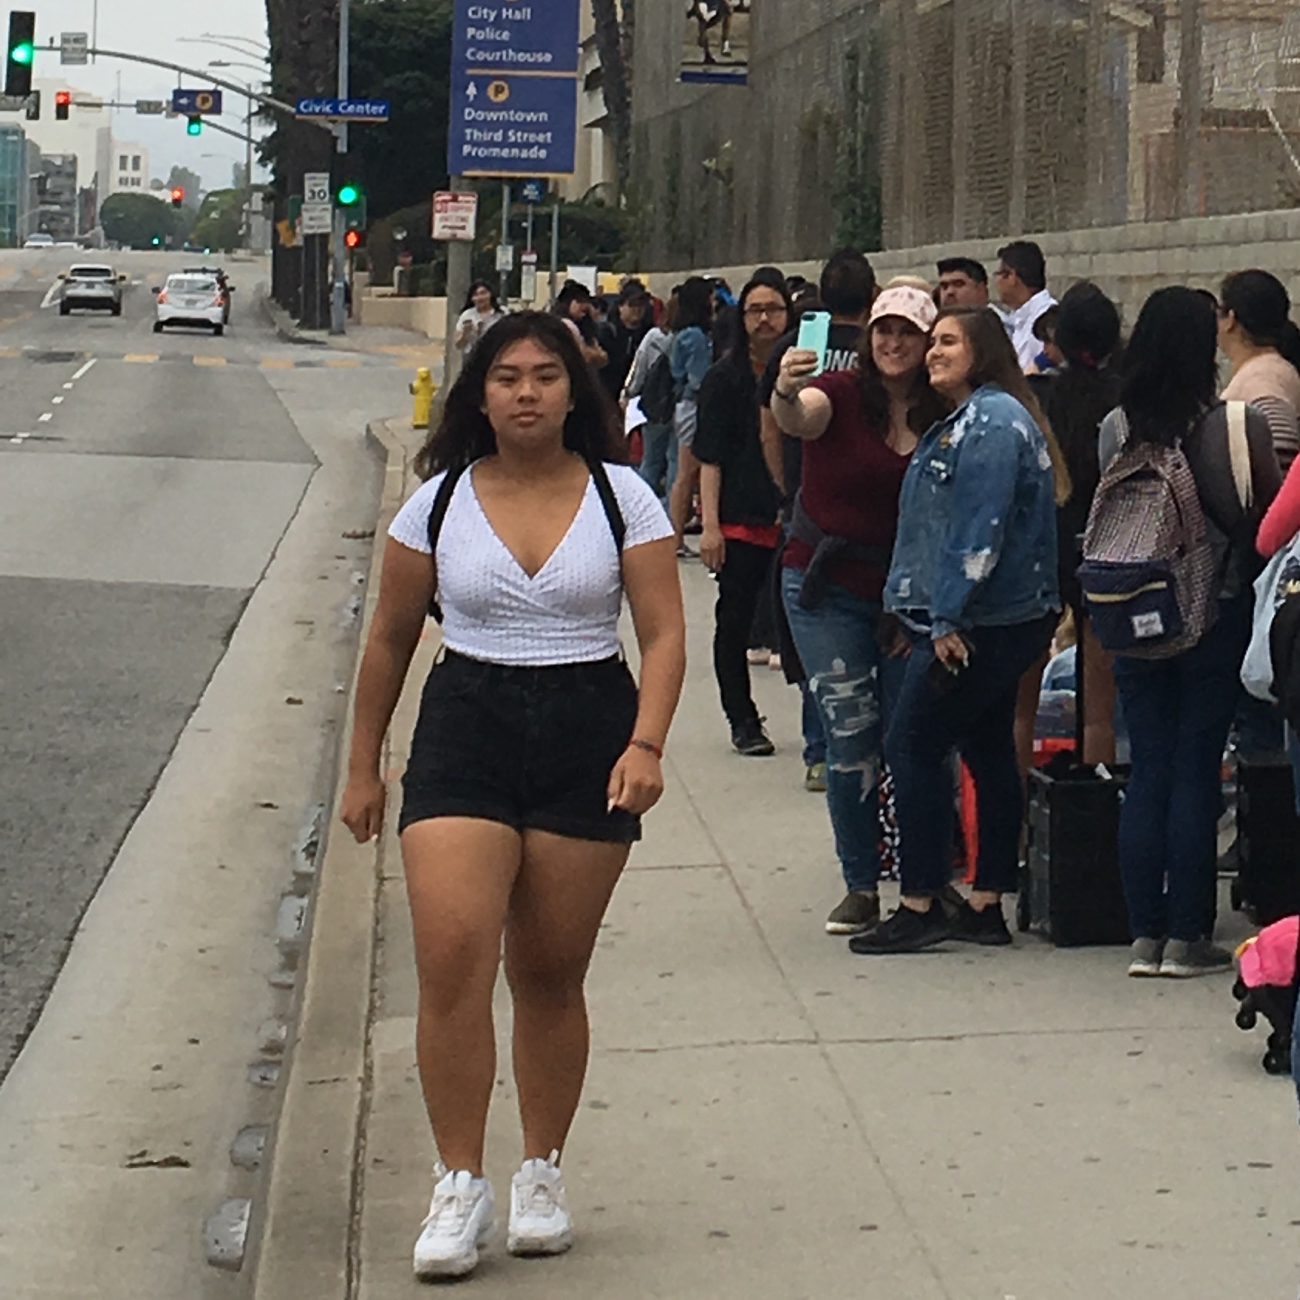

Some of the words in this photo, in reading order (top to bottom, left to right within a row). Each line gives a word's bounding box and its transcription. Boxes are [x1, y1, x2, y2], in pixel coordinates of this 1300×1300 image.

[467, 6, 497, 22] City
[502, 7, 532, 20] Hall
[466, 27, 511, 41] Police
[465, 48, 552, 63] Courthouse
[494, 84, 506, 98] P
[299, 100, 333, 113] Civic
[339, 101, 386, 115] Center
[463, 107, 549, 122] Downtown
[464, 128, 503, 142] Third
[507, 129, 552, 144] Street
[462, 144, 547, 159] Promenade
[307, 189, 327, 201] 30
